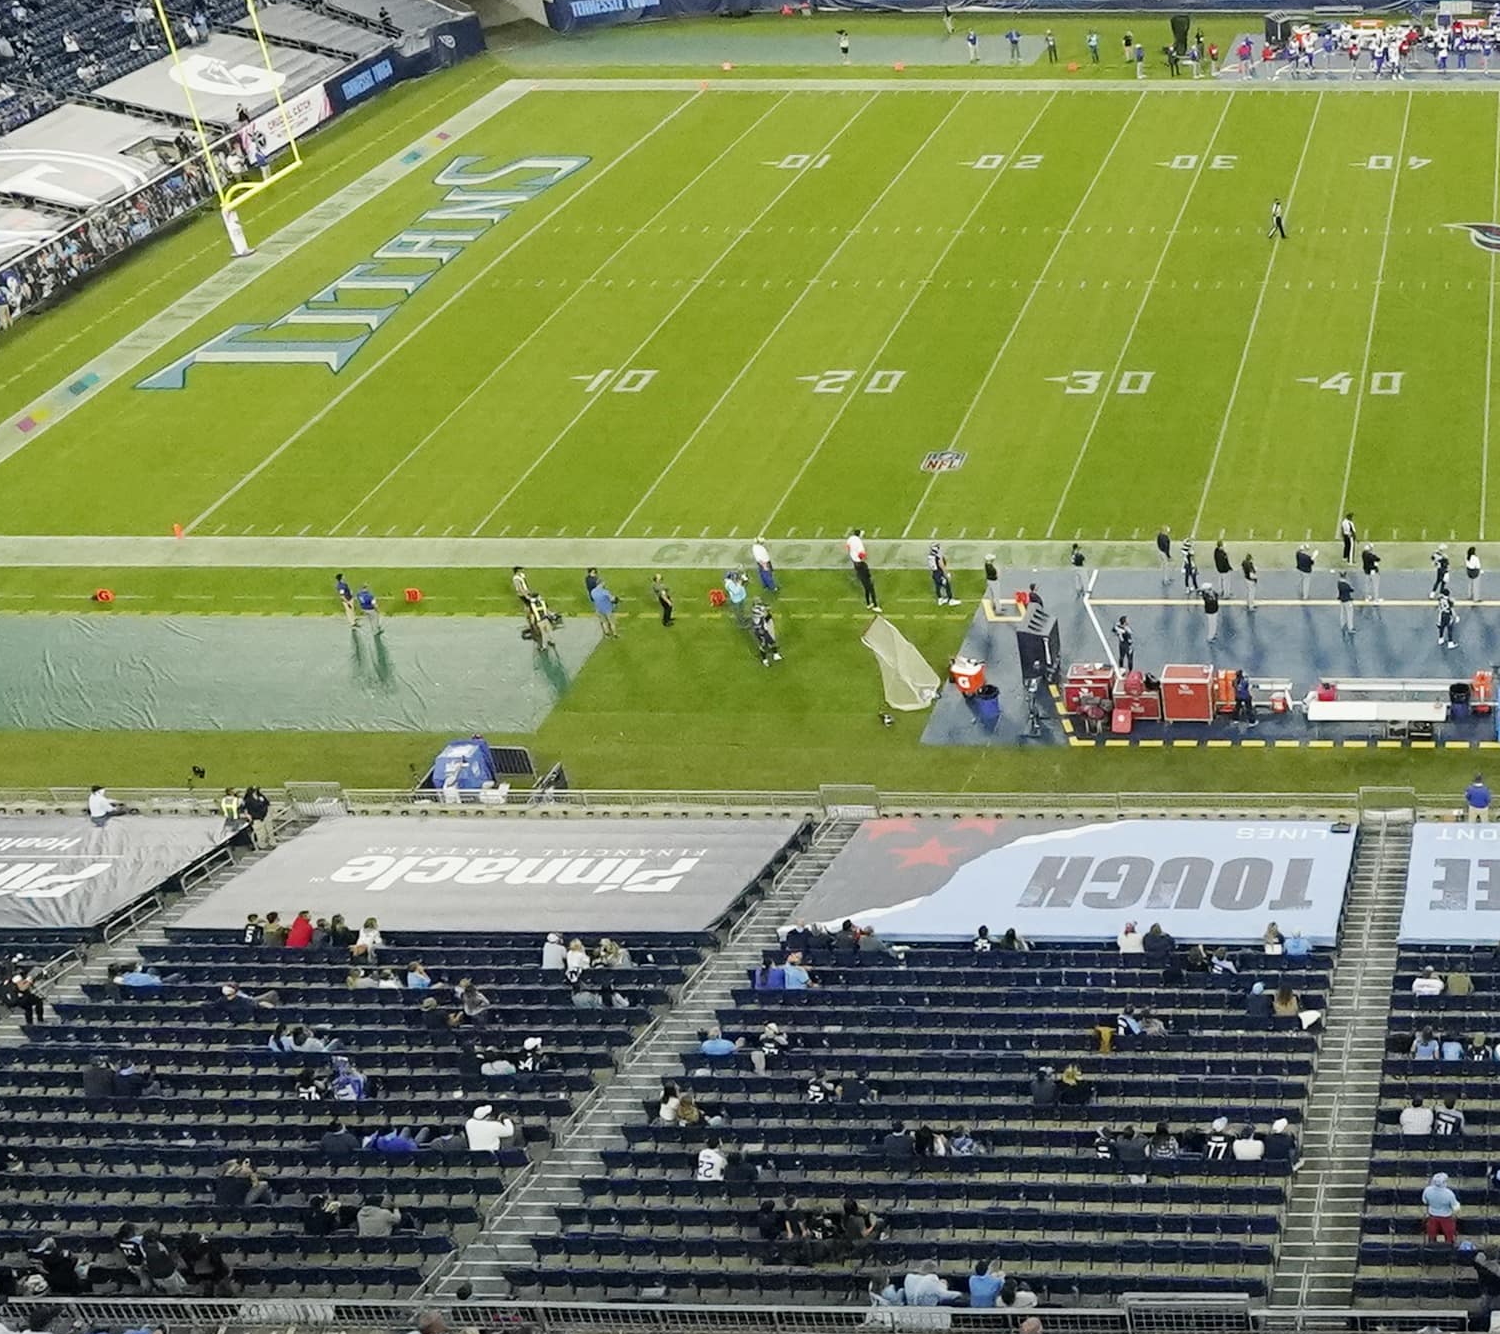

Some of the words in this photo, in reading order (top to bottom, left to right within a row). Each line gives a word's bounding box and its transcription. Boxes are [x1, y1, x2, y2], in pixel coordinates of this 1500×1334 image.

[133, 155, 592, 390] TITANS
[584, 369, 660, 394] 10
[812, 370, 907, 395] 20
[1064, 370, 1155, 395] 30
[1319, 371, 1404, 395] 40
[1236, 827, 1328, 840] LINES
[330, 855, 700, 895] Pinnacle
[1017, 855, 1314, 911] TOUGH
